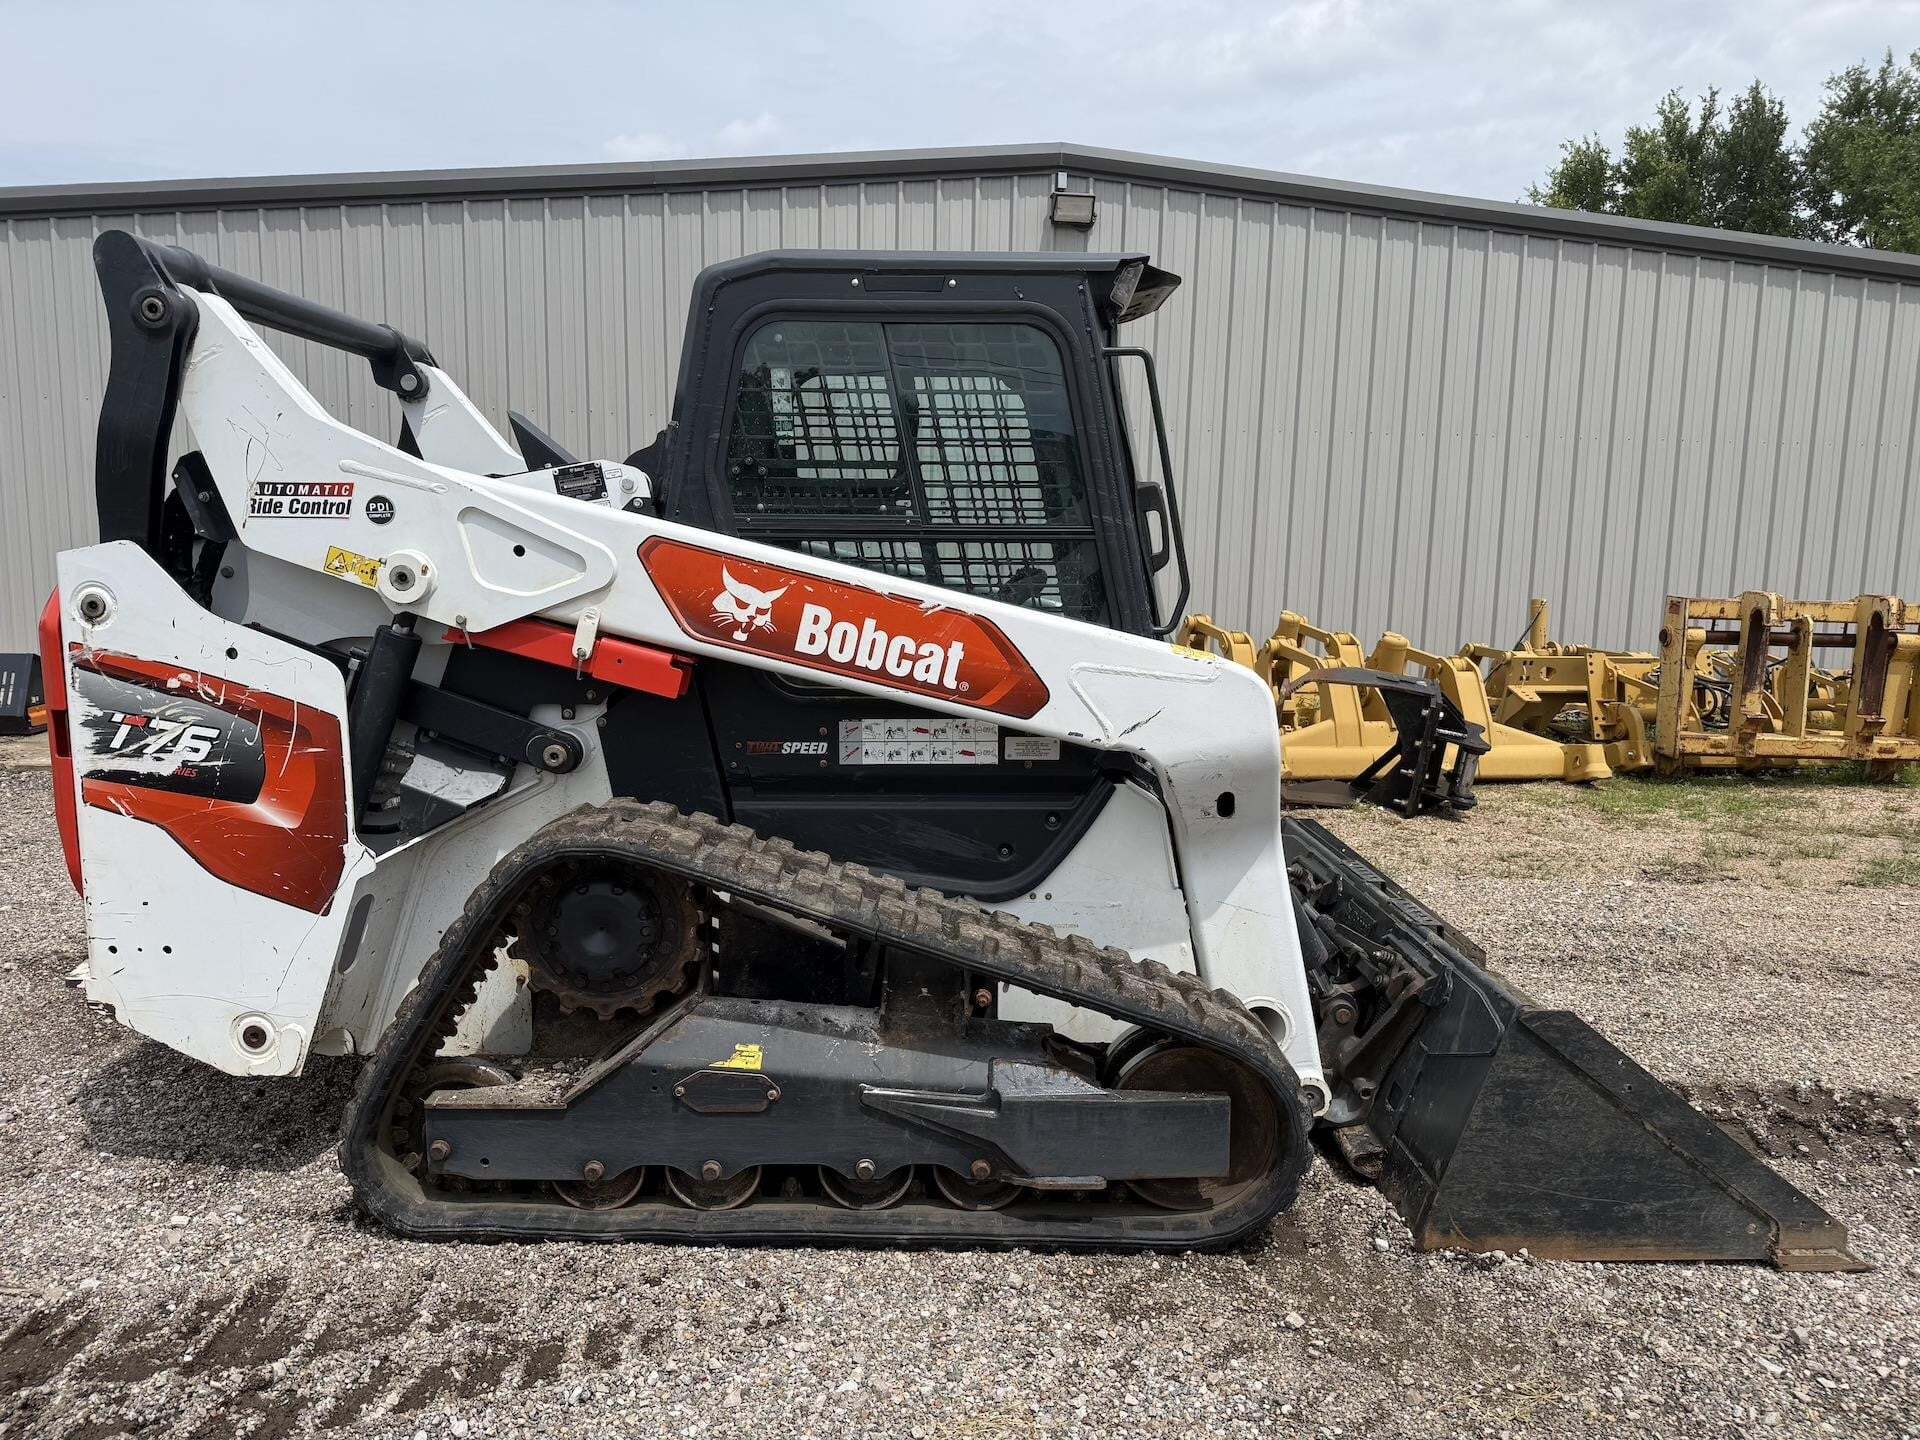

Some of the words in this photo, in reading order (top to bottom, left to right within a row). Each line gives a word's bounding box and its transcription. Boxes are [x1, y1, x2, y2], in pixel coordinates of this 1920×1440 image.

[288, 498, 351, 515] Control
[369, 502, 390, 512] PDI
[794, 602, 965, 690] Bobcat
[781, 741, 829, 755] SPEED
